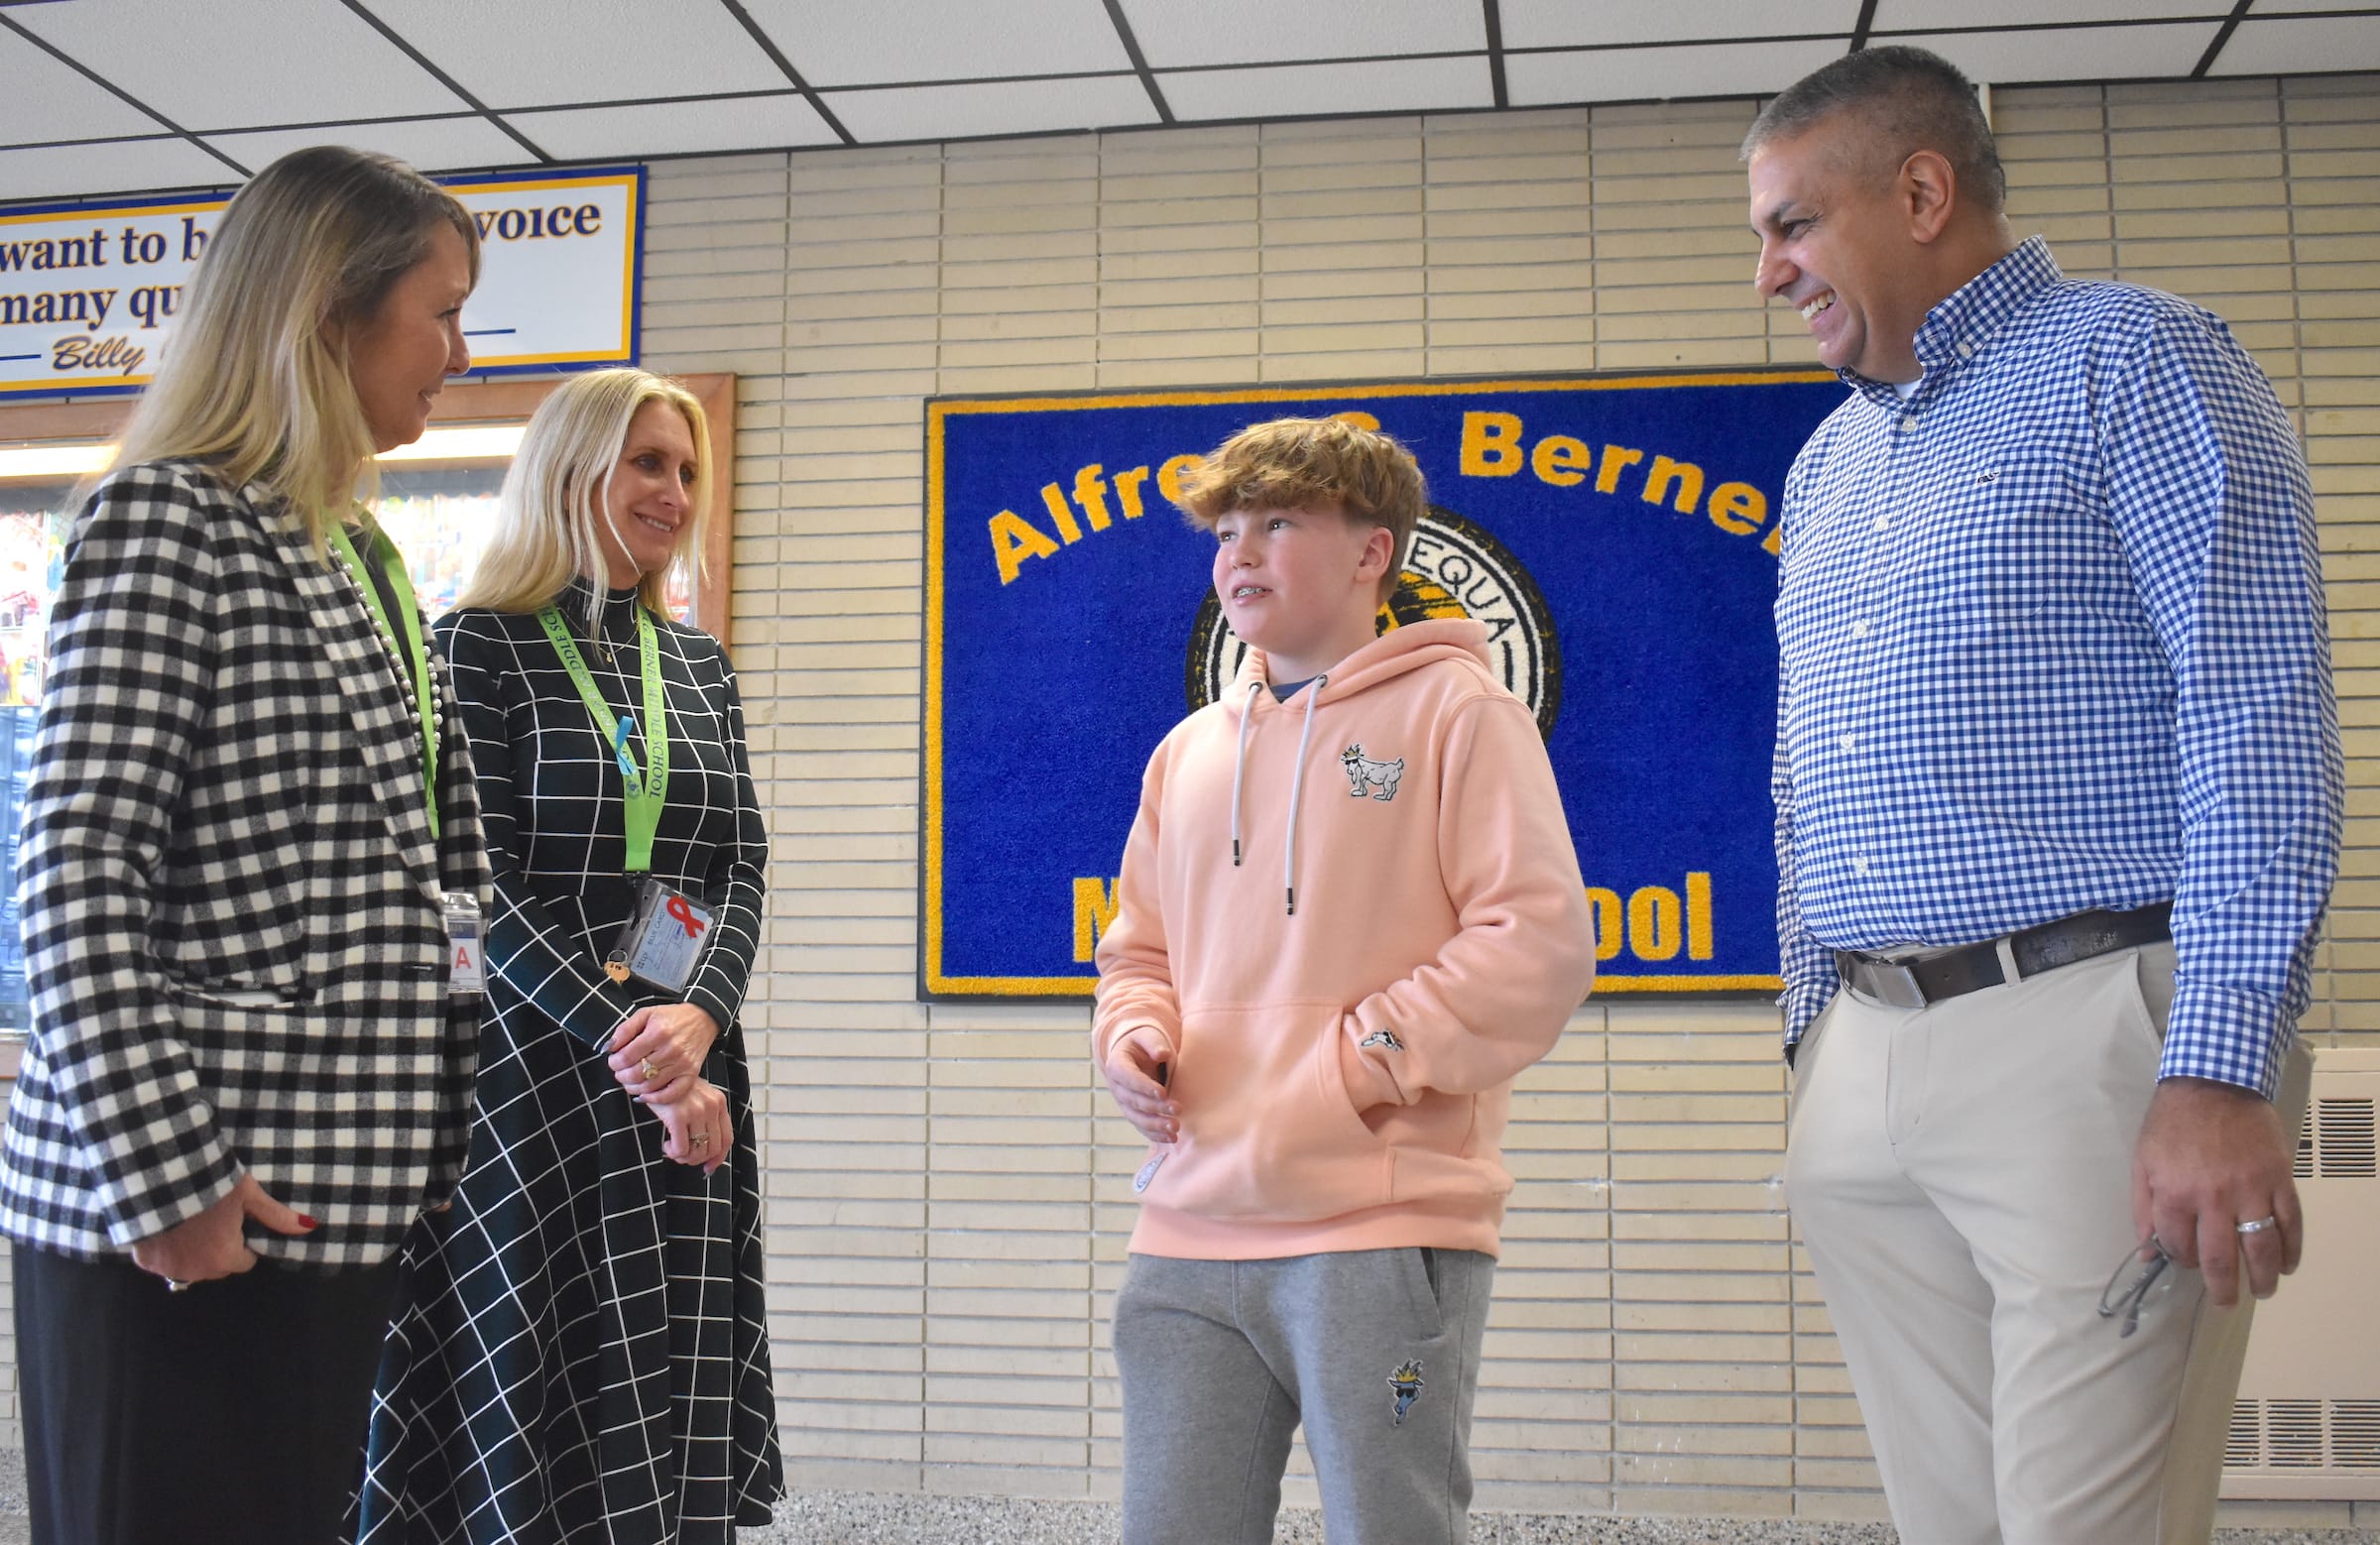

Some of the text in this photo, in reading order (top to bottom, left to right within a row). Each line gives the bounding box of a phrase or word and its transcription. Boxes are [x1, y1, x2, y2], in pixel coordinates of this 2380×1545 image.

[0, 227, 108, 272] want
[120, 226, 167, 266] to
[473, 202, 603, 242] voice
[0, 288, 118, 331] many
[53, 334, 146, 377] Billy
[1460, 411, 1781, 557] Berne
[650, 739, 665, 798] SCHOOL
